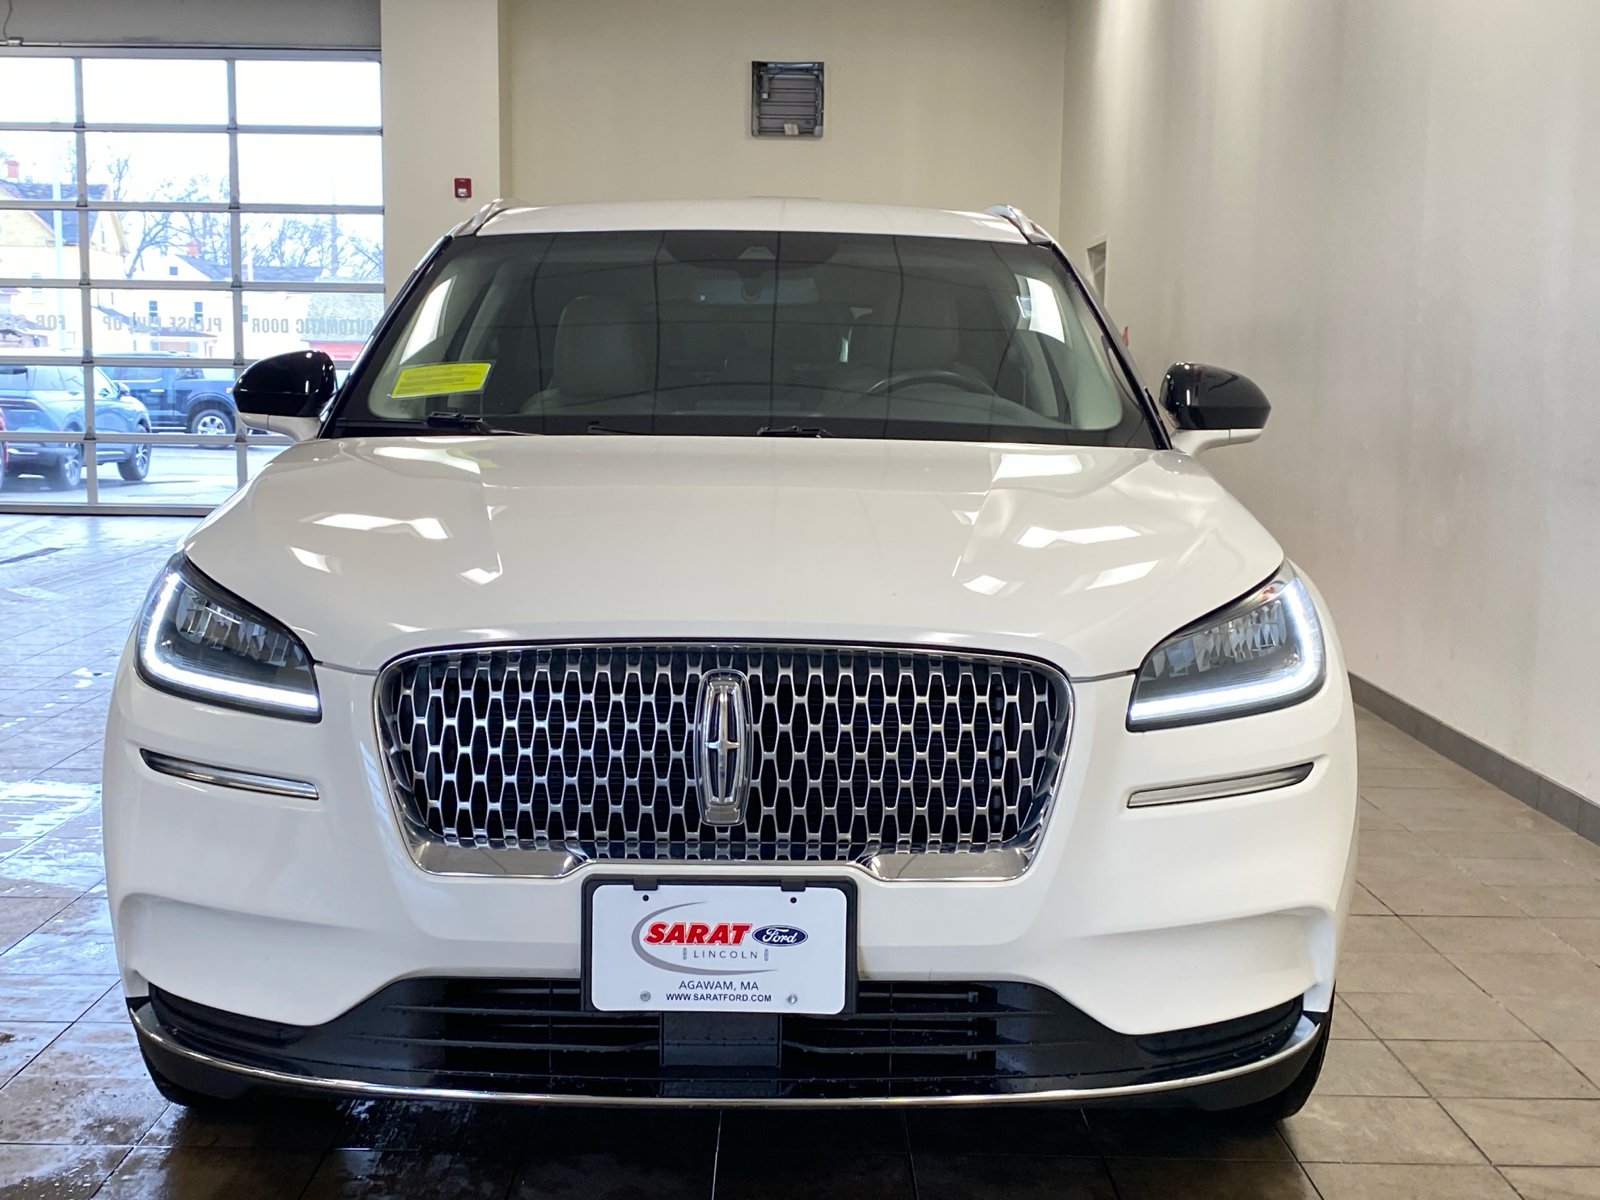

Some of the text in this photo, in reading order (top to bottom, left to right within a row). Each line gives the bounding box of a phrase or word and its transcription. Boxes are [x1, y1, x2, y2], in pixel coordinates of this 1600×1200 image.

[644, 922, 799, 946] SARAT Ford
[693, 950, 758, 959] LINCOLN
[678, 981, 759, 991] AGAWAM, MA
[665, 993, 772, 1003] WWW.SARATFORD.COM
